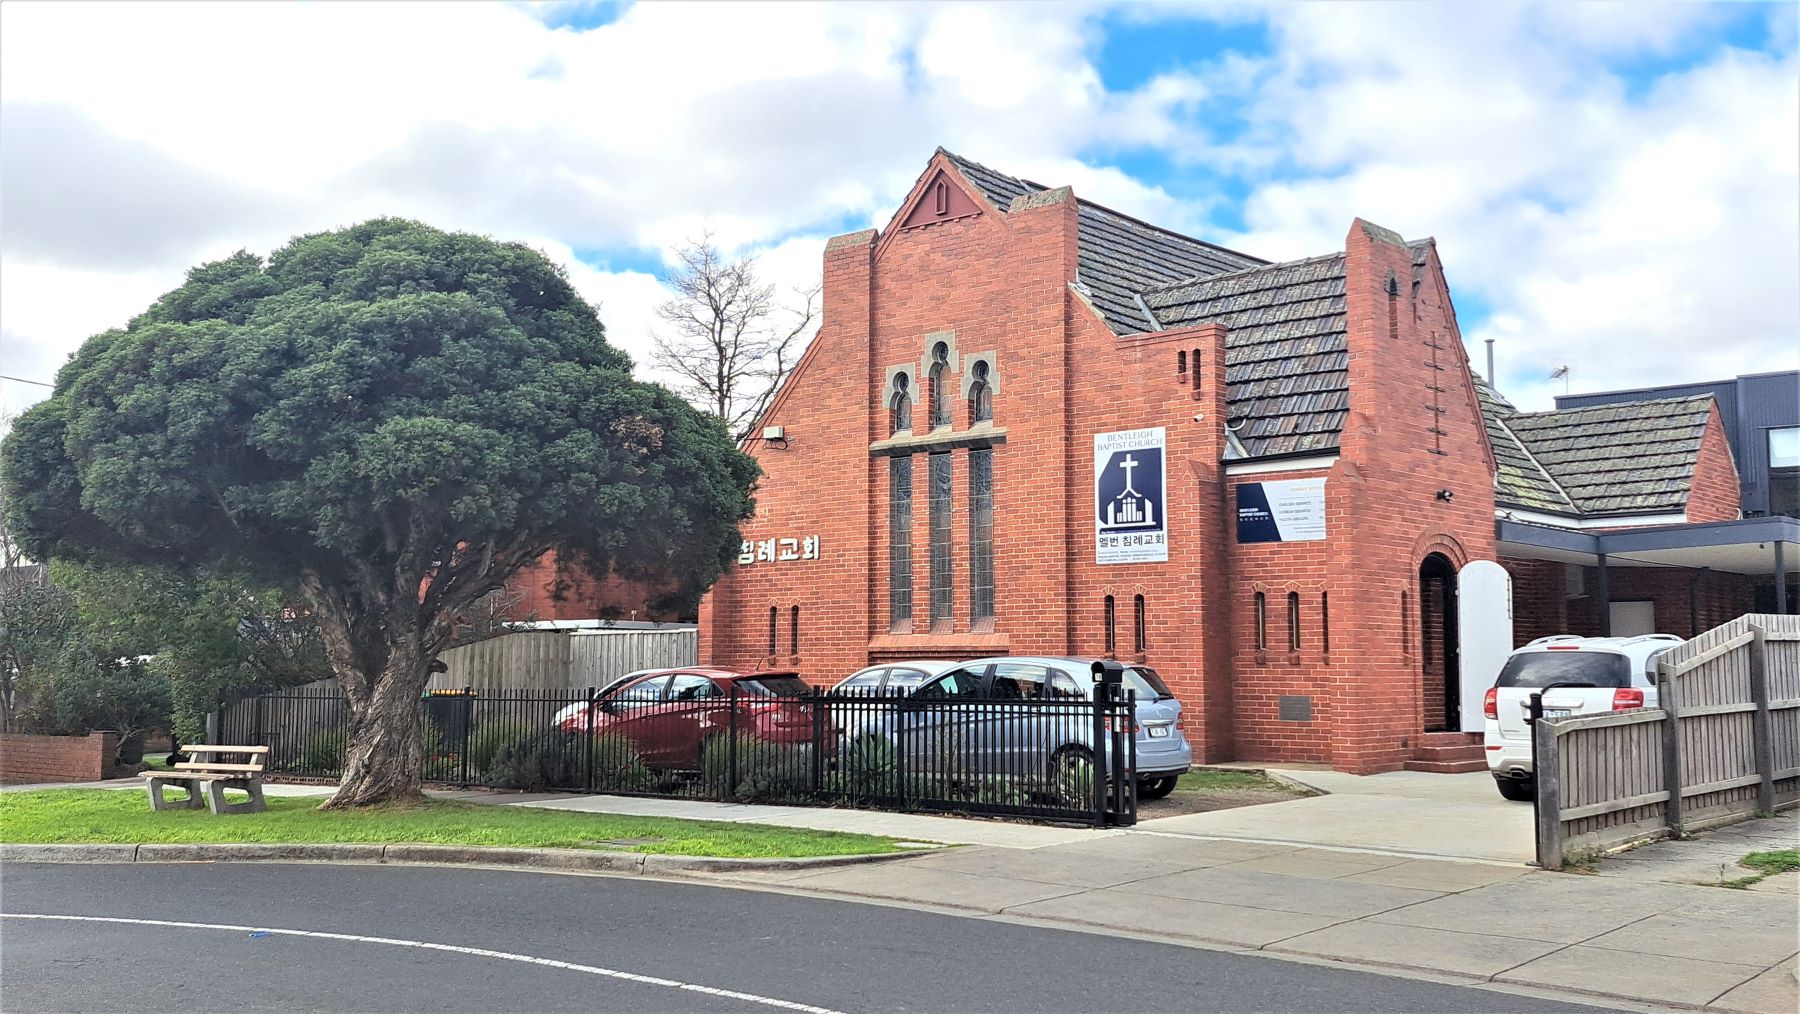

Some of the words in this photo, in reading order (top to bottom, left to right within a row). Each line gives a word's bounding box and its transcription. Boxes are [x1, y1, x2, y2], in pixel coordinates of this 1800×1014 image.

[1107, 430, 1153, 442] BENTLEIGH
[1097, 441, 1127, 451] BAPTIST
[1128, 437, 1163, 448] CHURCH
[1099, 536, 1119, 548] 멜번
[1122, 533, 1165, 547] 침례교회
